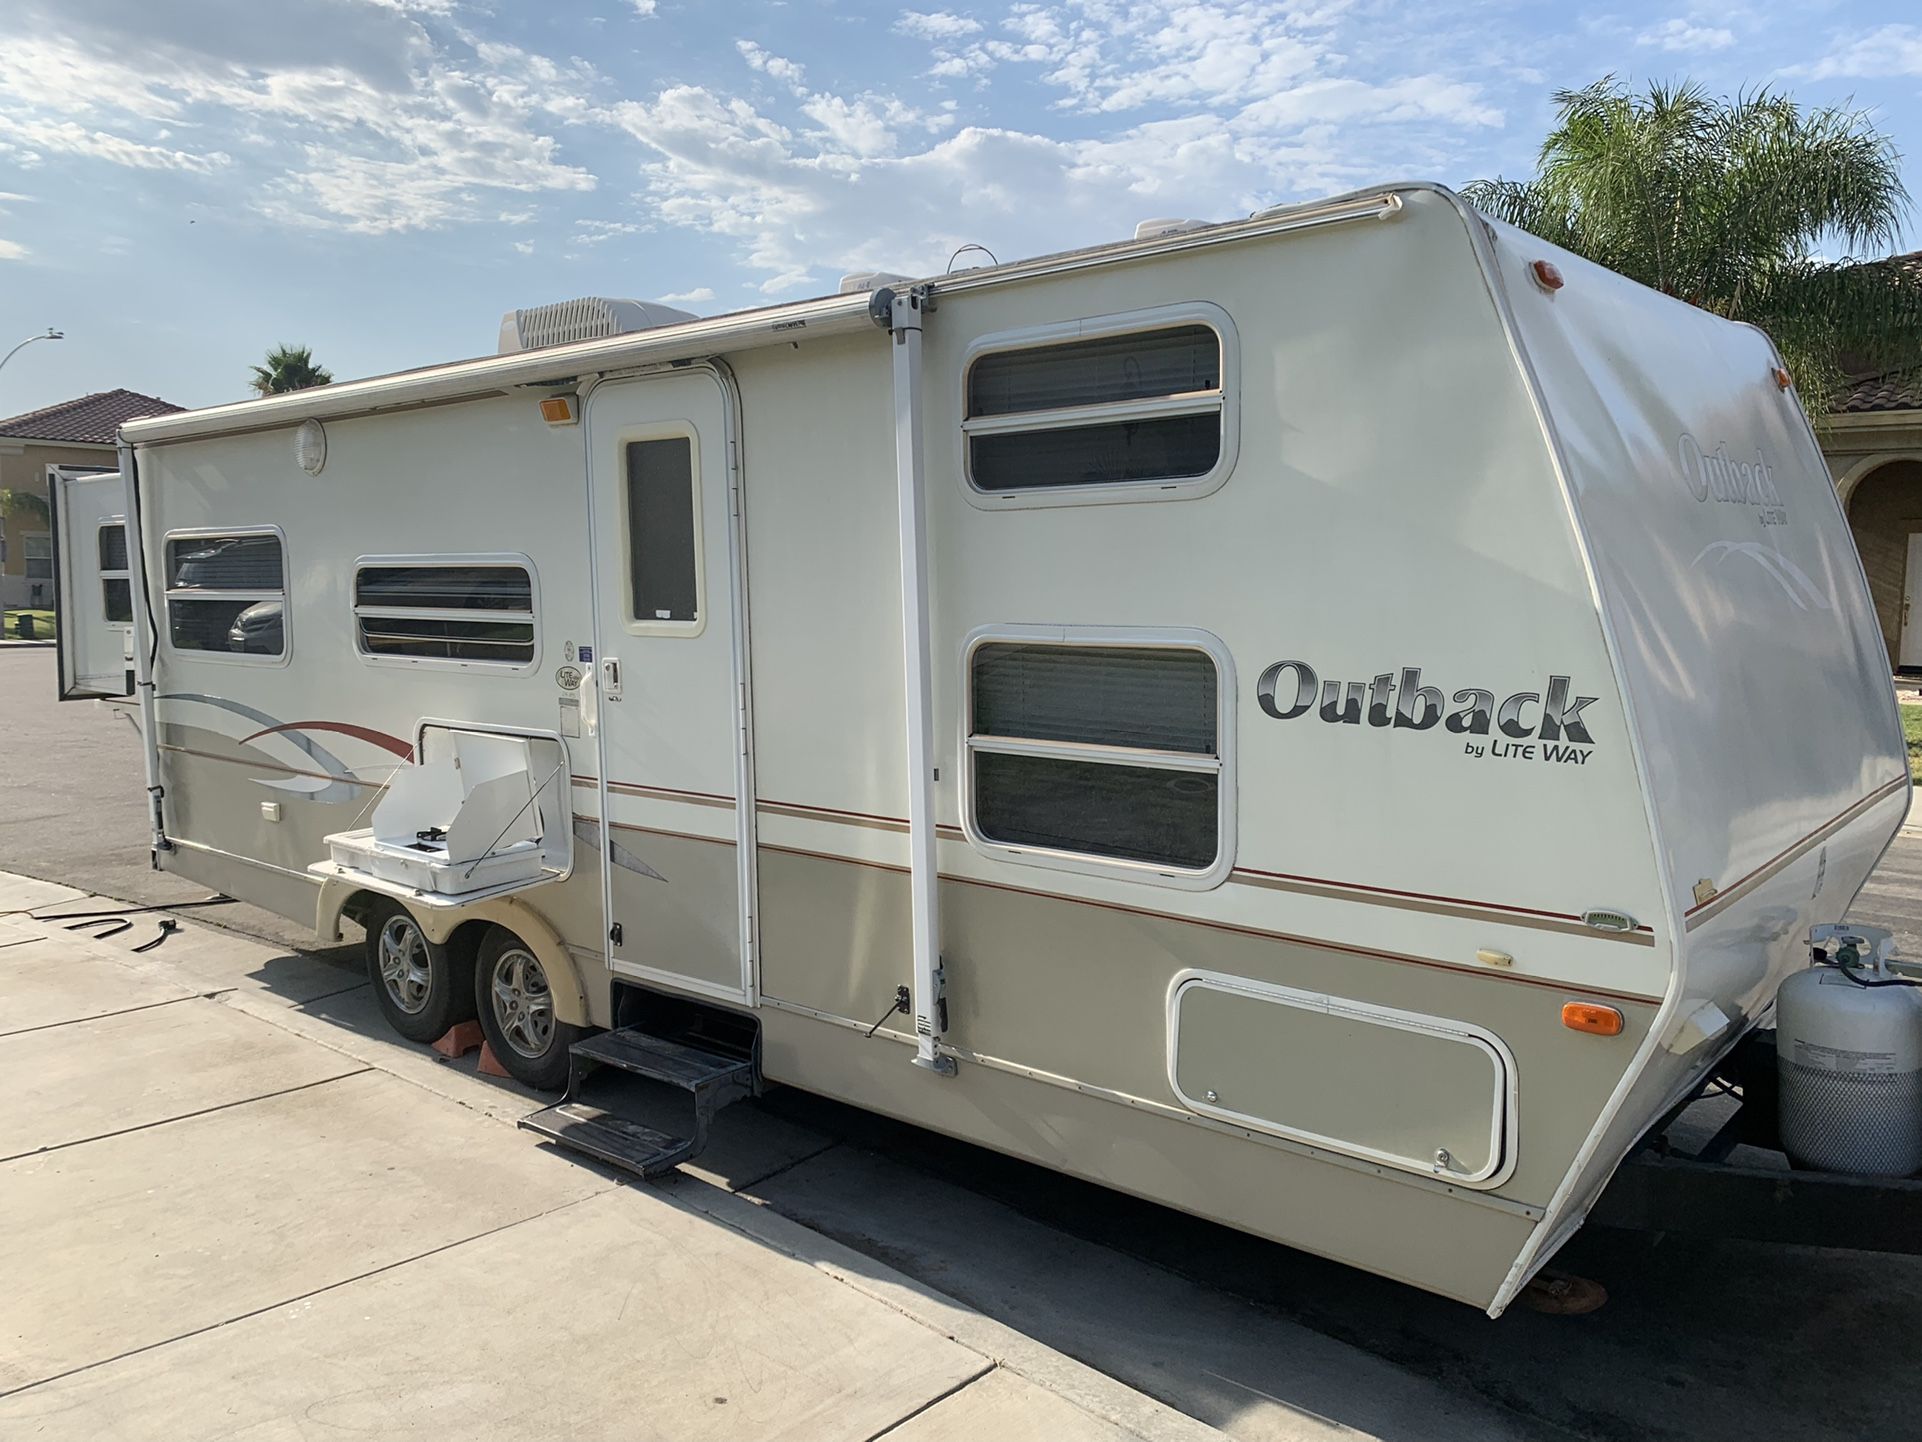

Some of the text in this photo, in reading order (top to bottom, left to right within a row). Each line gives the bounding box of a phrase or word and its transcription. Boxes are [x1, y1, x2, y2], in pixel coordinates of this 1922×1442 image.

[1678, 432, 1785, 506] Outback
[560, 670, 573, 679] LITE
[565, 678, 578, 687] WAY
[1257, 660, 1600, 744] Outback
[1465, 739, 1593, 765] by LITE WAY
